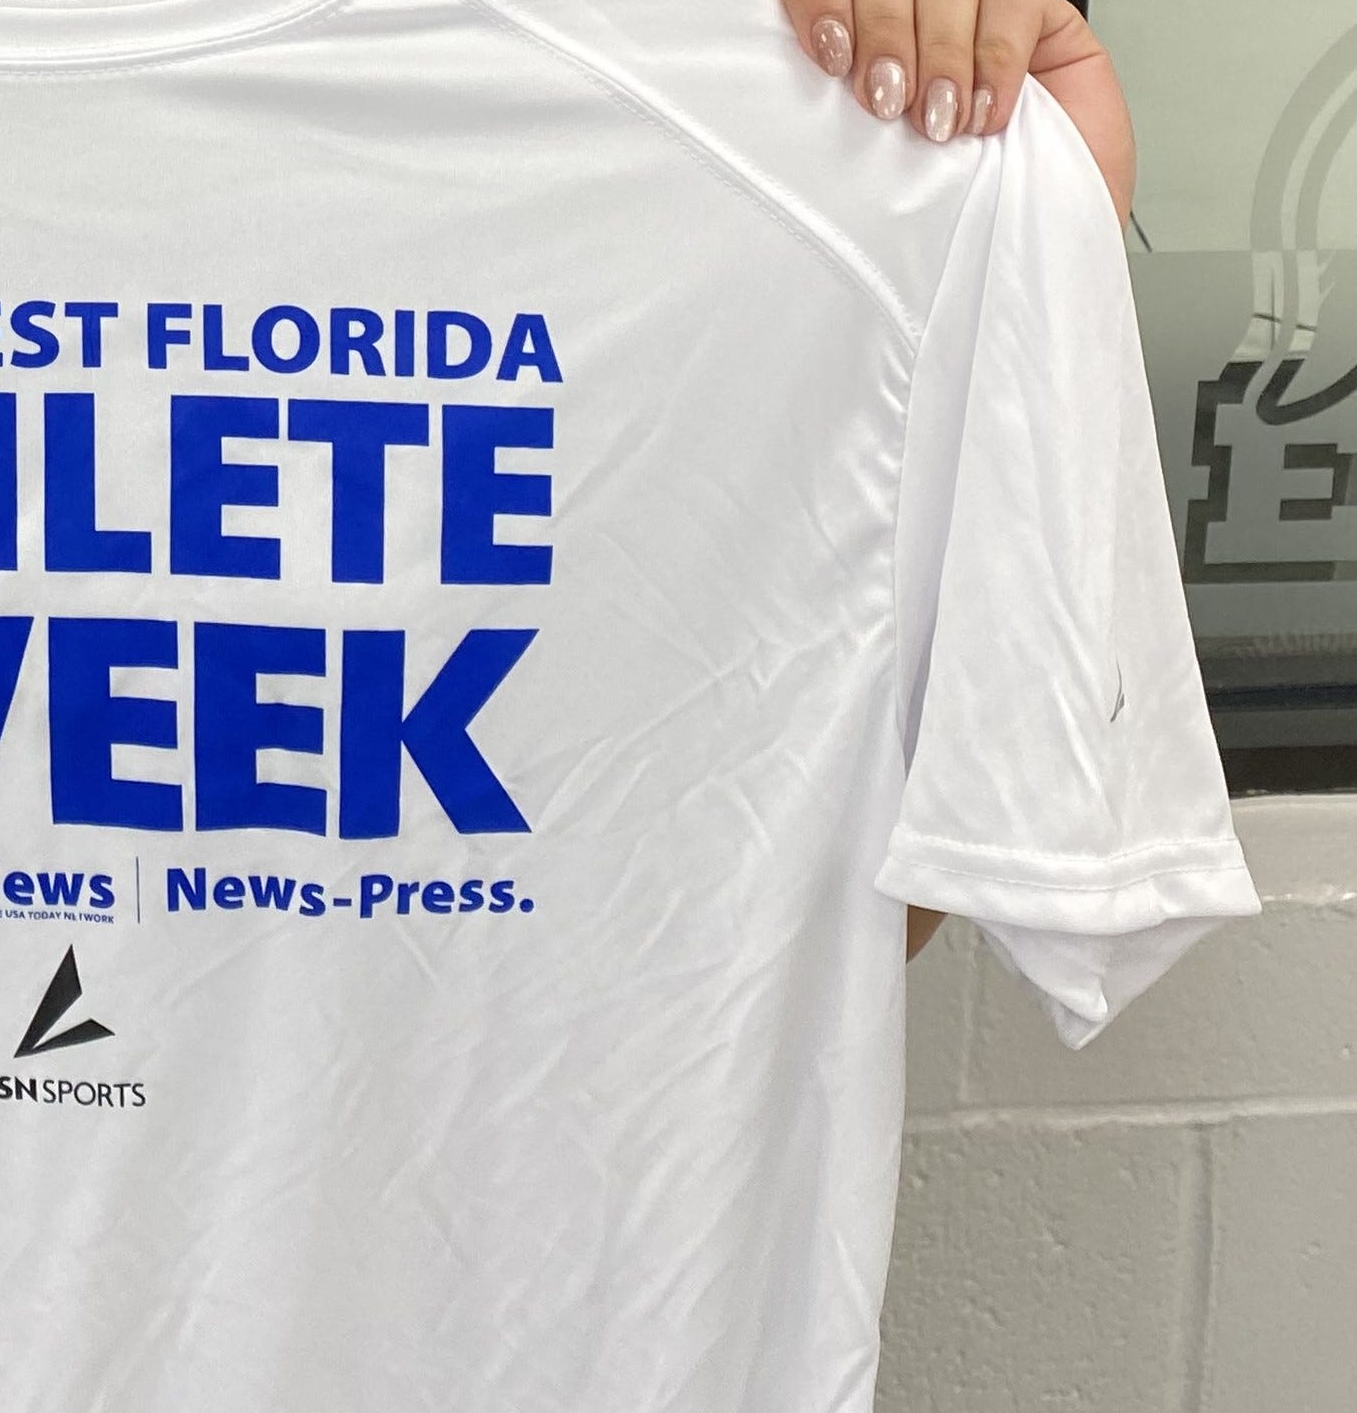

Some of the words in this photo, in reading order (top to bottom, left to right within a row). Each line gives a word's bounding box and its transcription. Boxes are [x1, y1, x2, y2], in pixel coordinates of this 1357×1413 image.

[146, 302, 563, 383] FLORIDA
[166, 867, 534, 918] News-Press.
[5, 910, 25, 919] USA
[28, 911, 61, 920] TODAY
[42, 1078, 146, 1108] SPORTS
